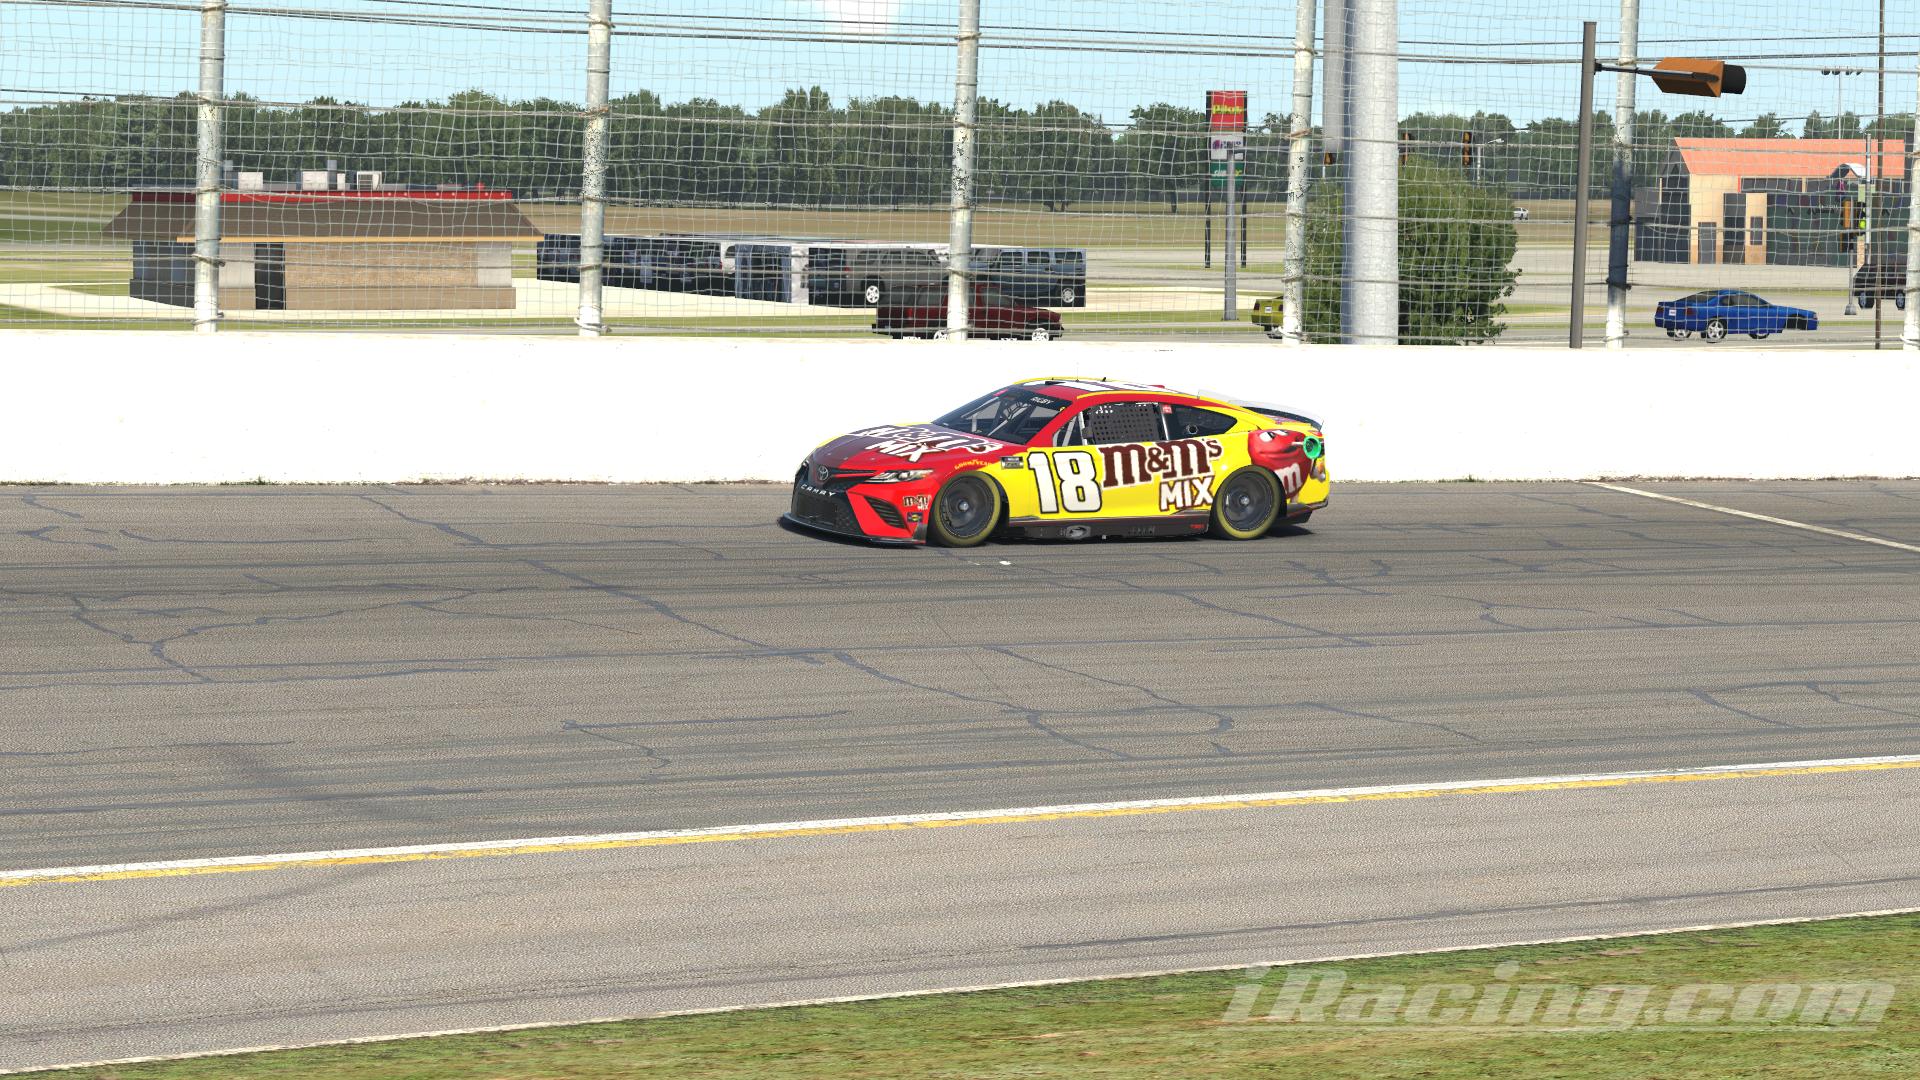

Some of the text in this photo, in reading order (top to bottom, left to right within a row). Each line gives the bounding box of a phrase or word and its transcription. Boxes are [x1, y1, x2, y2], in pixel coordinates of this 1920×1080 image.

[800, 483, 837, 497] CAMRY
[1027, 450, 1103, 514] 18
[1159, 475, 1215, 511] MIX
